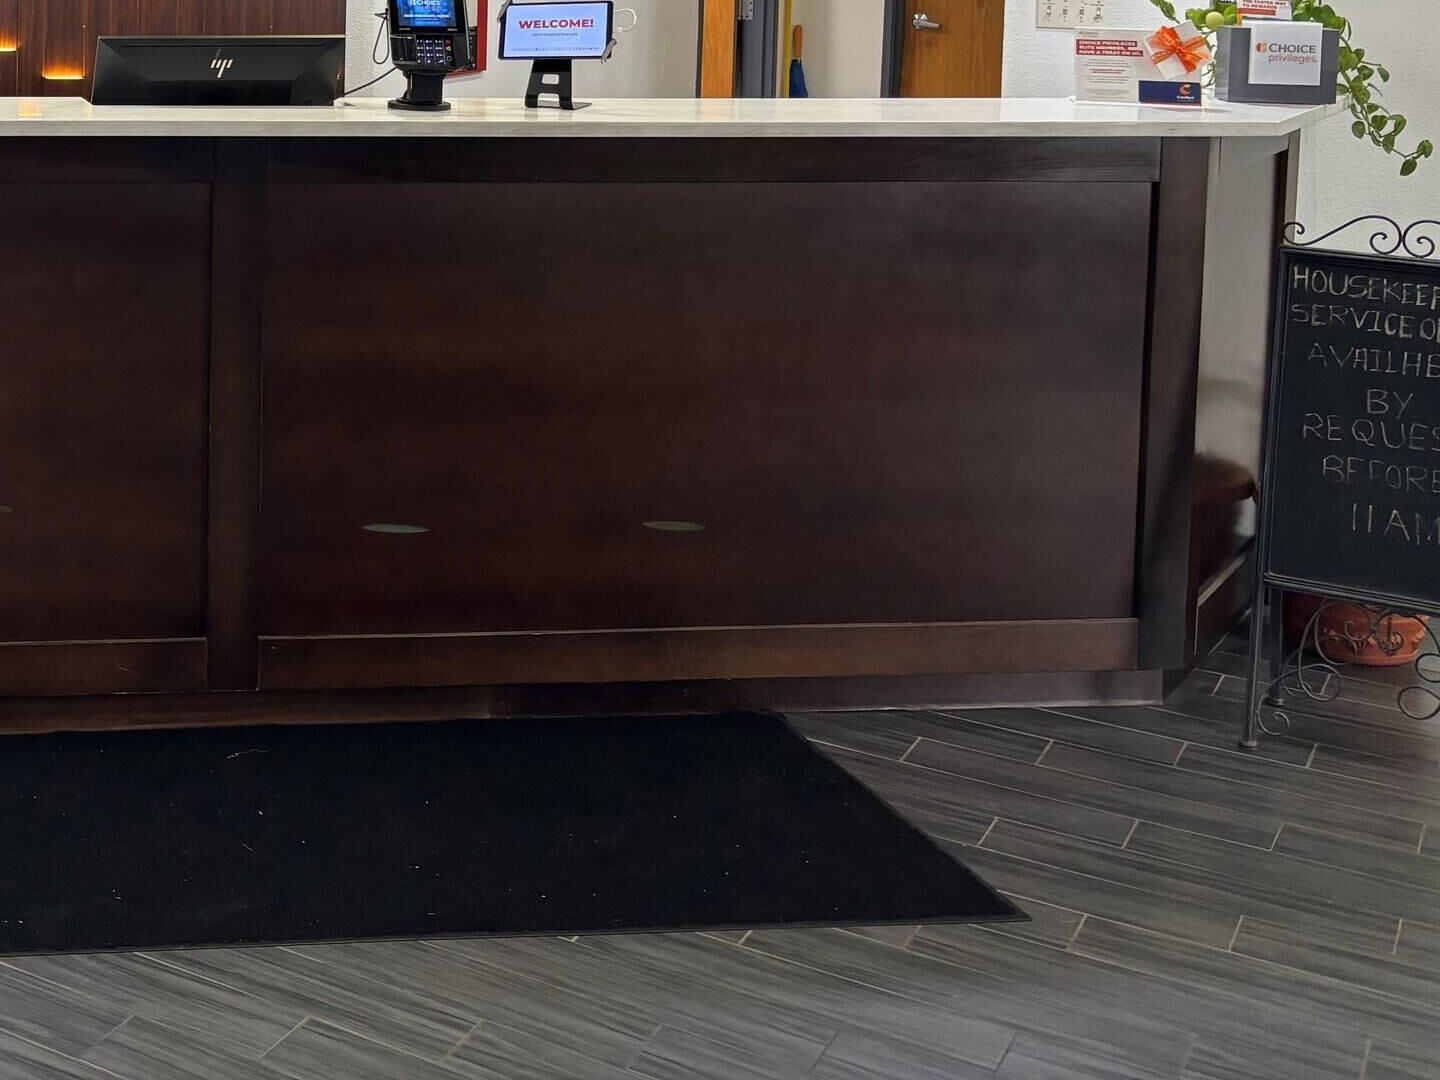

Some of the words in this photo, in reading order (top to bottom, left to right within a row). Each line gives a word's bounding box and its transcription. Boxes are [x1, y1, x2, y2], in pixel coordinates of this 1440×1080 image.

[518, 19, 594, 29] WELCOME!
[1268, 43, 1317, 54] CHOICE
[1268, 54, 1317, 64] privileges
[1291, 304, 1416, 339] SERVICE
[1420, 318, 1440, 343] O
[1366, 388, 1414, 419] BY
